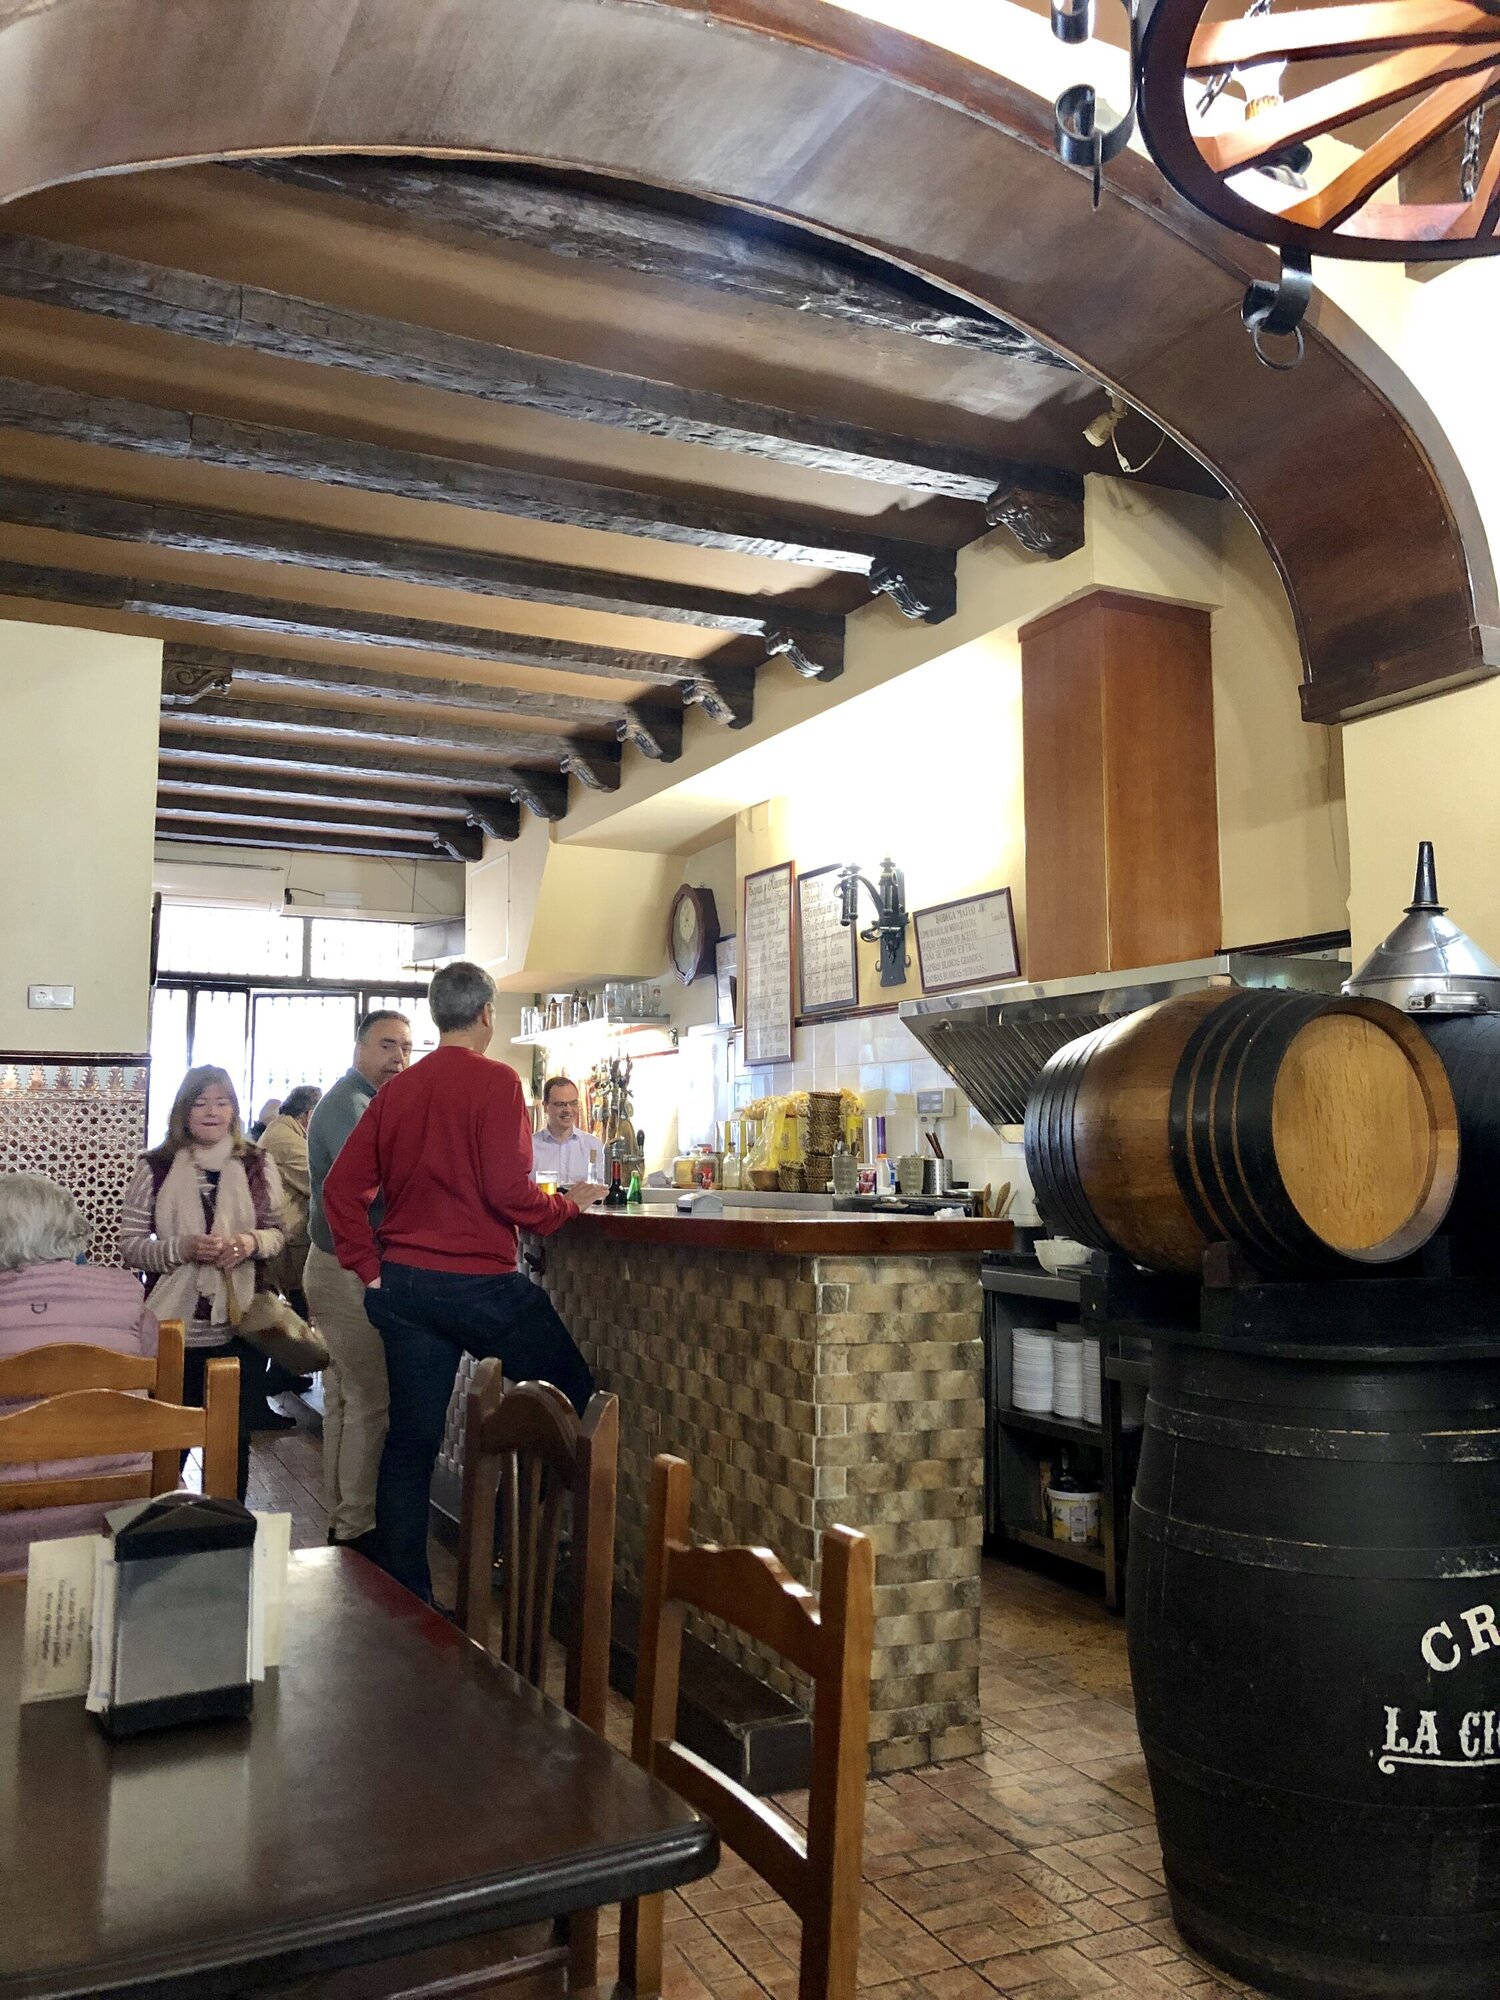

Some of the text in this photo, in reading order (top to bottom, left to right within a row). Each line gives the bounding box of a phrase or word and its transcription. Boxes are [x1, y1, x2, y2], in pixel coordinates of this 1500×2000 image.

[956, 905, 975, 918] MATEO
[935, 949, 942, 959] DE
[1382, 1705, 1500, 1758] LA CI
